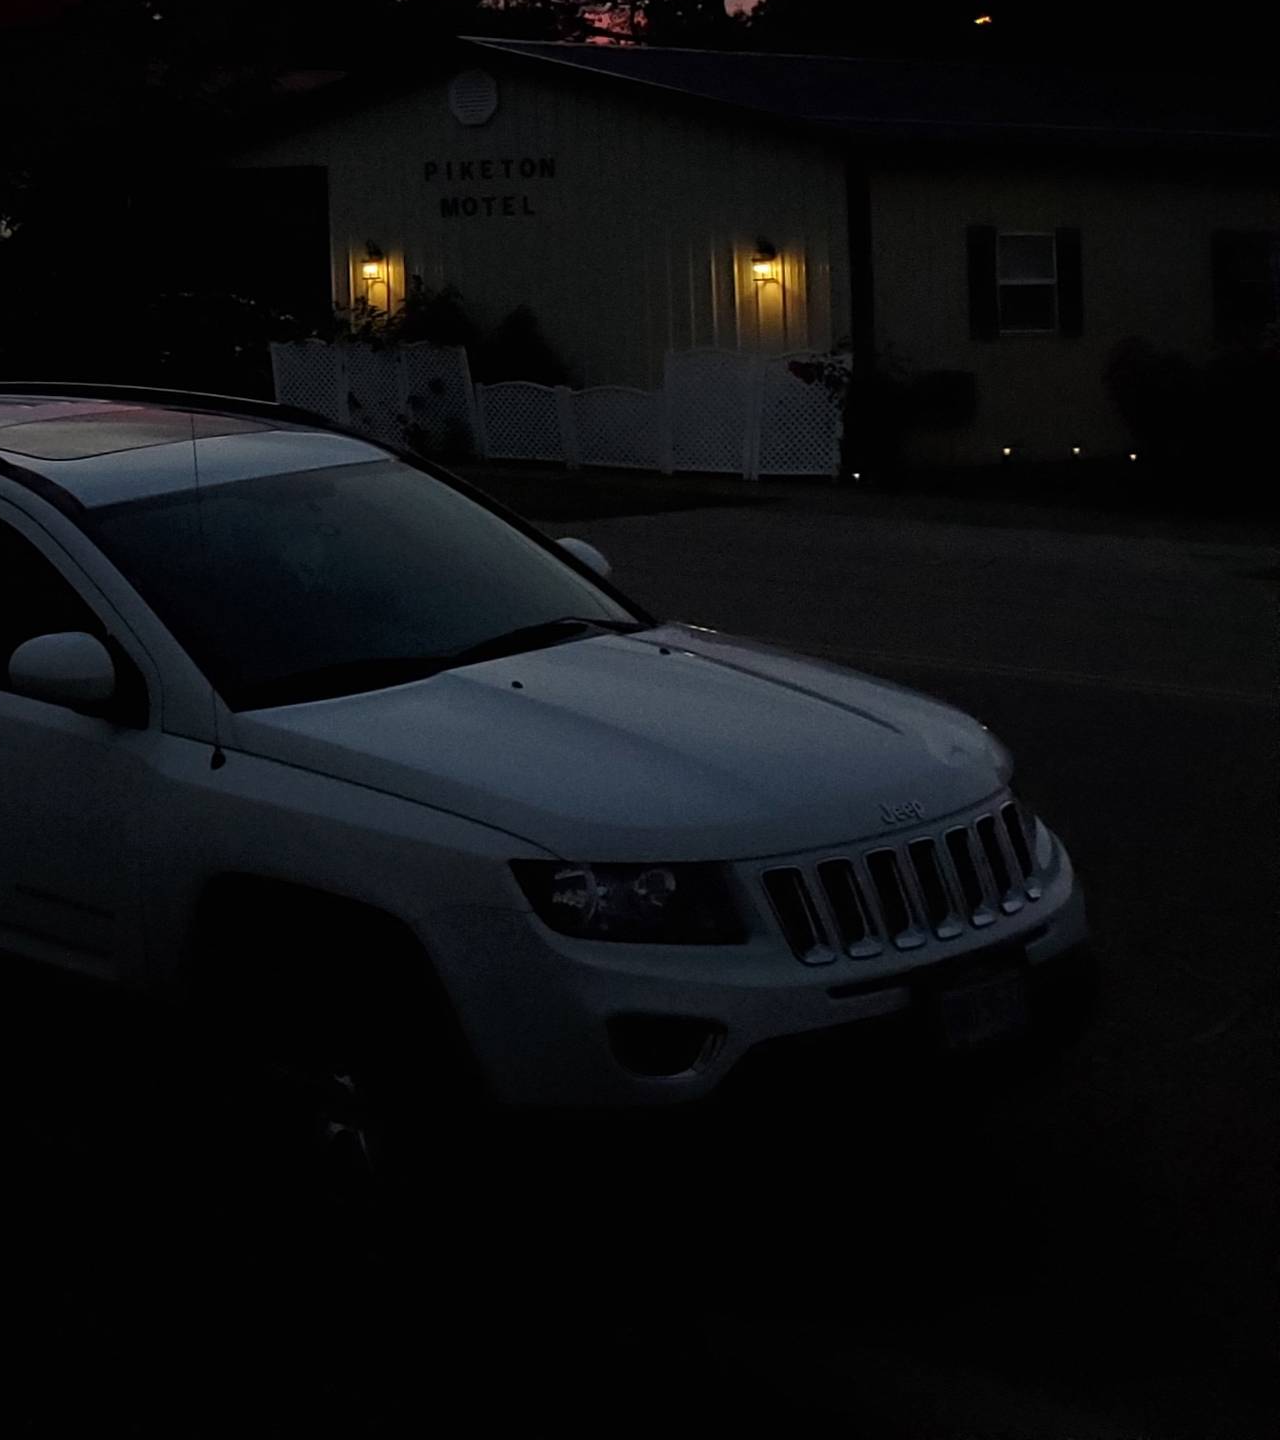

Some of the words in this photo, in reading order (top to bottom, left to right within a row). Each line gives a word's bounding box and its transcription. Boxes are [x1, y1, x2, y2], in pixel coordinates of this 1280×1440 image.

[424, 159, 556, 181] PIKETON
[441, 196, 535, 217] MOTEL
[880, 800, 925, 824] Jeep
